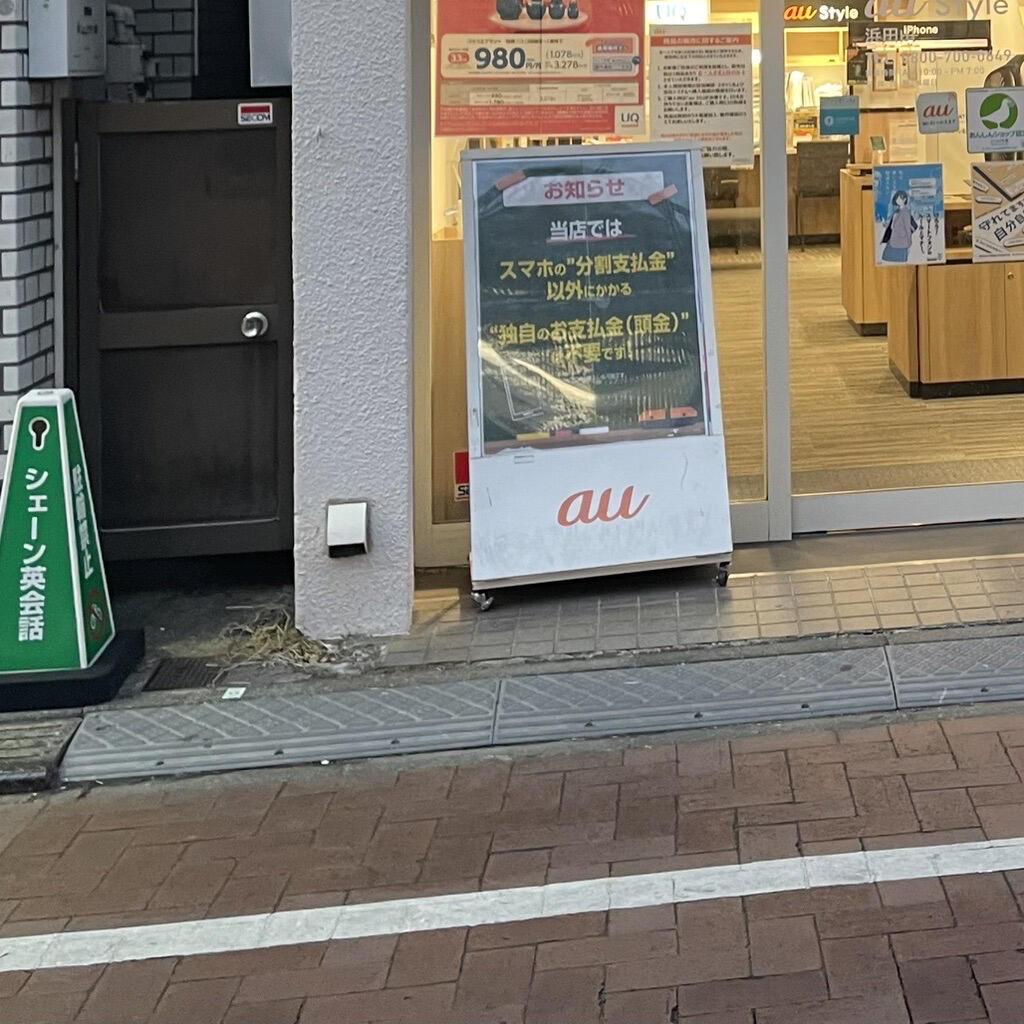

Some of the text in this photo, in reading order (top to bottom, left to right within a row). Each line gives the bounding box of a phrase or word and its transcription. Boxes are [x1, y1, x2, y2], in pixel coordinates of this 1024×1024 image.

[783, 4, 859, 22] au Style
[474, 47, 526, 69] 980
[620, 112, 640, 123] UQ
[922, 103, 954, 118] au
[543, 178, 625, 200] お知らせ
[549, 219, 624, 241] 当店では
[546, 280, 633, 301] 以外にかかる
[557, 485, 650, 527] au
[17, 467, 49, 642] シェーン英会話
